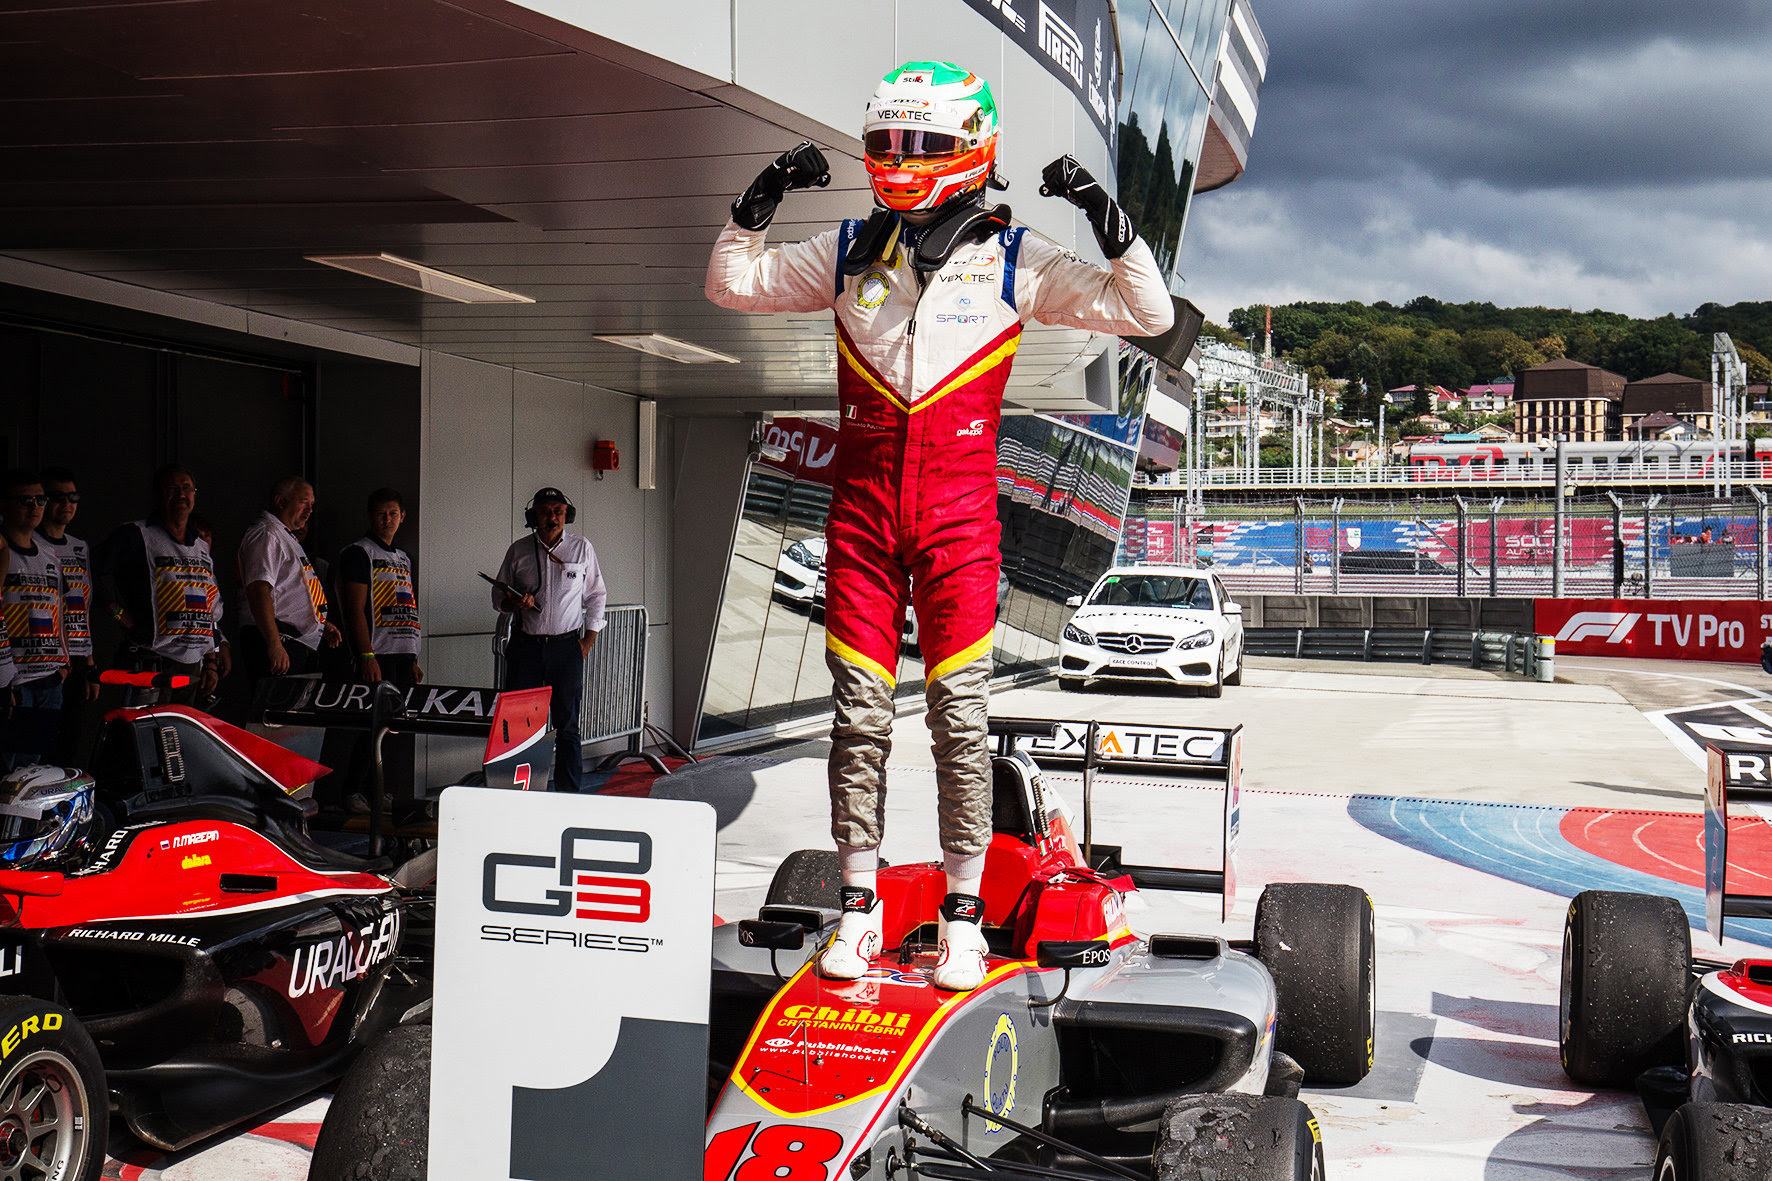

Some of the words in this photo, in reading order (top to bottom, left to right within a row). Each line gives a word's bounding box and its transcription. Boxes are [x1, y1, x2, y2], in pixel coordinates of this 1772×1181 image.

[877, 110, 932, 122] VEXATEC
[939, 273, 995, 283] VEXATEC
[936, 313, 989, 324] SPORT
[1647, 613, 1692, 646] TV
[1699, 614, 1744, 648] Pro
[482, 827, 653, 923] GP3
[68, 928, 145, 942] RICHARD
[147, 932, 201, 947] MILLE
[480, 925, 649, 953] SERIES
[1082, 948, 1110, 964] EPOS
[783, 1005, 911, 1029] Ghibli
[777, 1018, 860, 1032] CRISTANINI
[862, 1024, 906, 1036] CBRN
